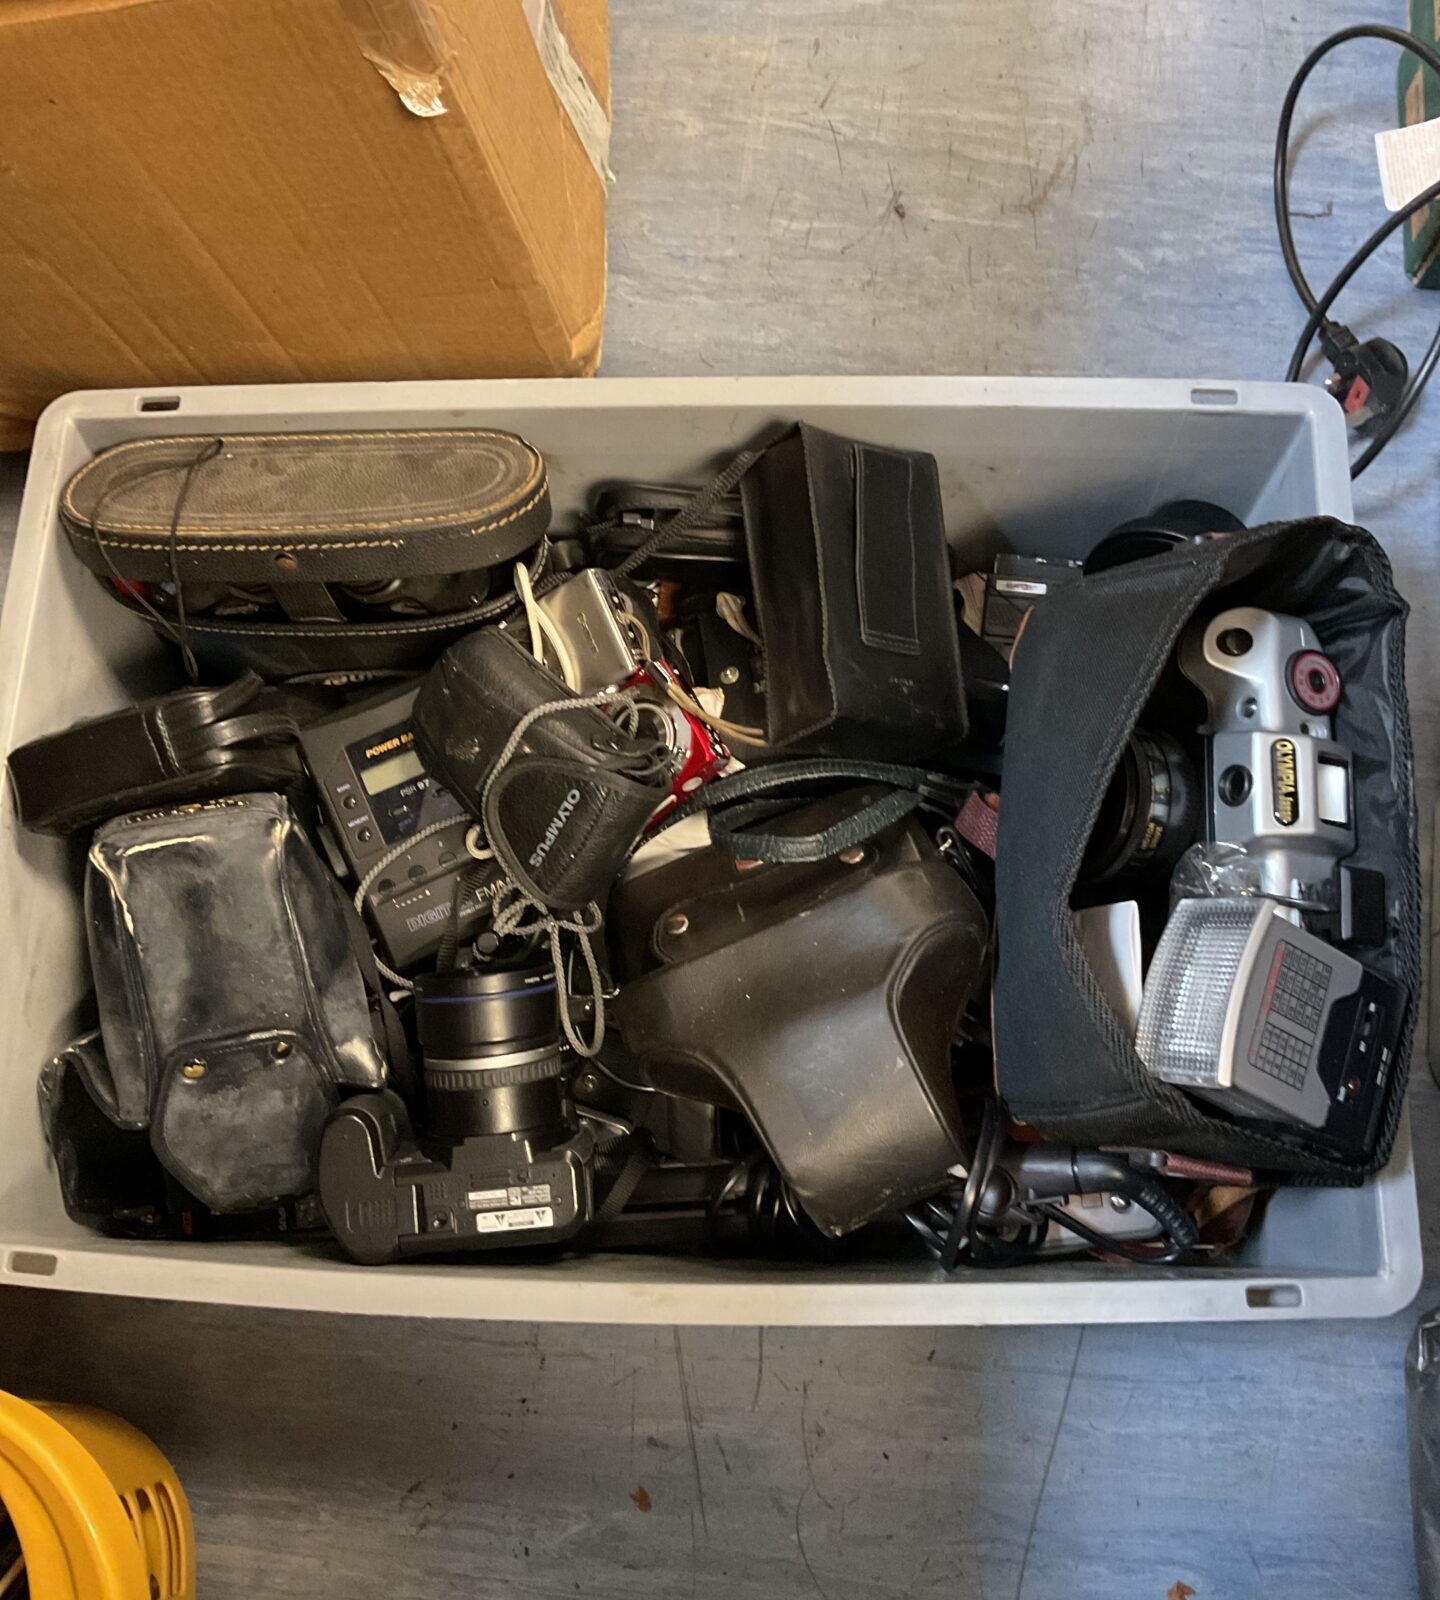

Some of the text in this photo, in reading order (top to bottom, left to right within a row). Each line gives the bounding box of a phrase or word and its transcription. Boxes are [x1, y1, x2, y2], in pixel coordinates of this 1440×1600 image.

[365, 731, 415, 759] POWER BA
[1275, 740, 1296, 796] OLYMPIA
[528, 788, 581, 868] OLYMPUS
[406, 901, 453, 933] DIGIT
